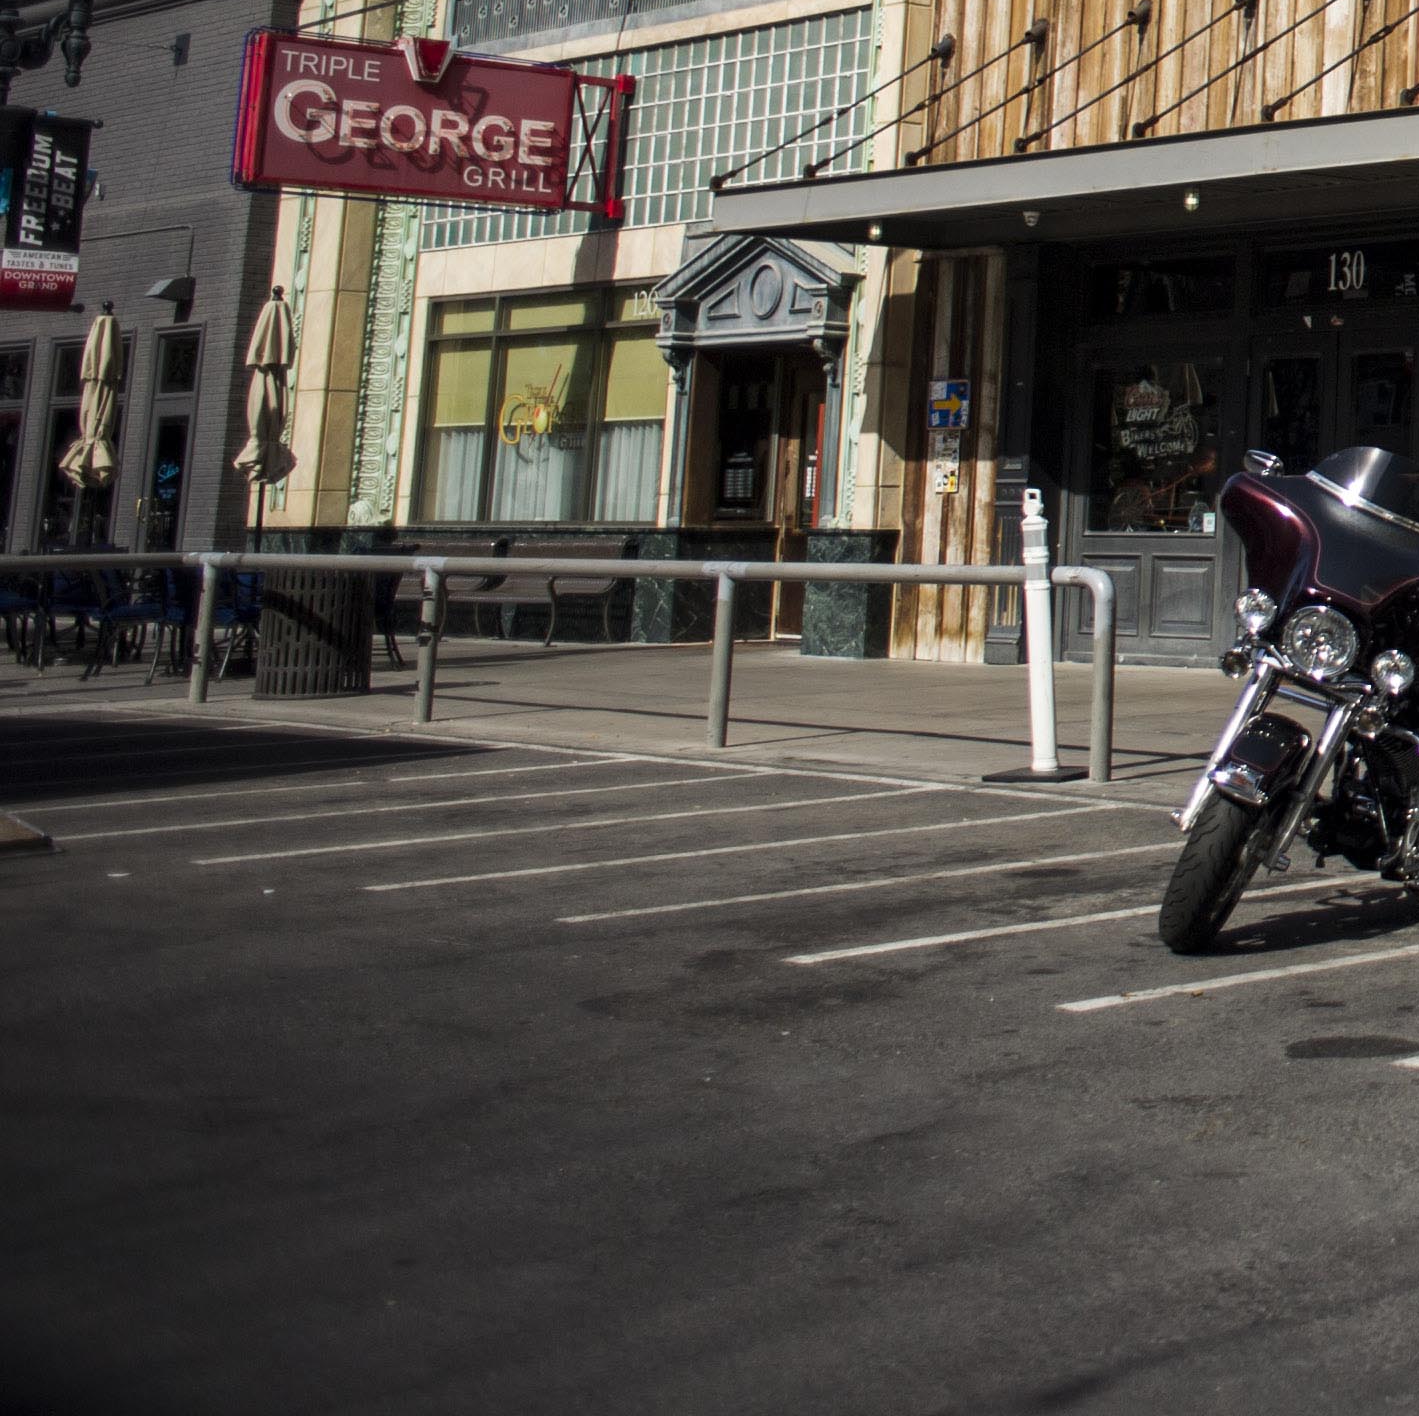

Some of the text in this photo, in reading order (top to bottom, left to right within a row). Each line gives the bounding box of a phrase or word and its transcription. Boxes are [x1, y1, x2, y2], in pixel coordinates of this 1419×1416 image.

[281, 50, 381, 83] TRIPLE
[273, 79, 556, 167] GEORGE
[51, 150, 79, 210] BEAT
[463, 166, 553, 194] GRILL
[6, 259, 36, 269] TASTES
[22, 251, 63, 261] AMERICAN
[4, 270, 75, 283] DOWNTOWN
[1327, 250, 1366, 292] 130
[18, 280, 59, 291] GRAND
[632, 290, 659, 317] 120
[1126, 407, 1161, 423] LIGHT
